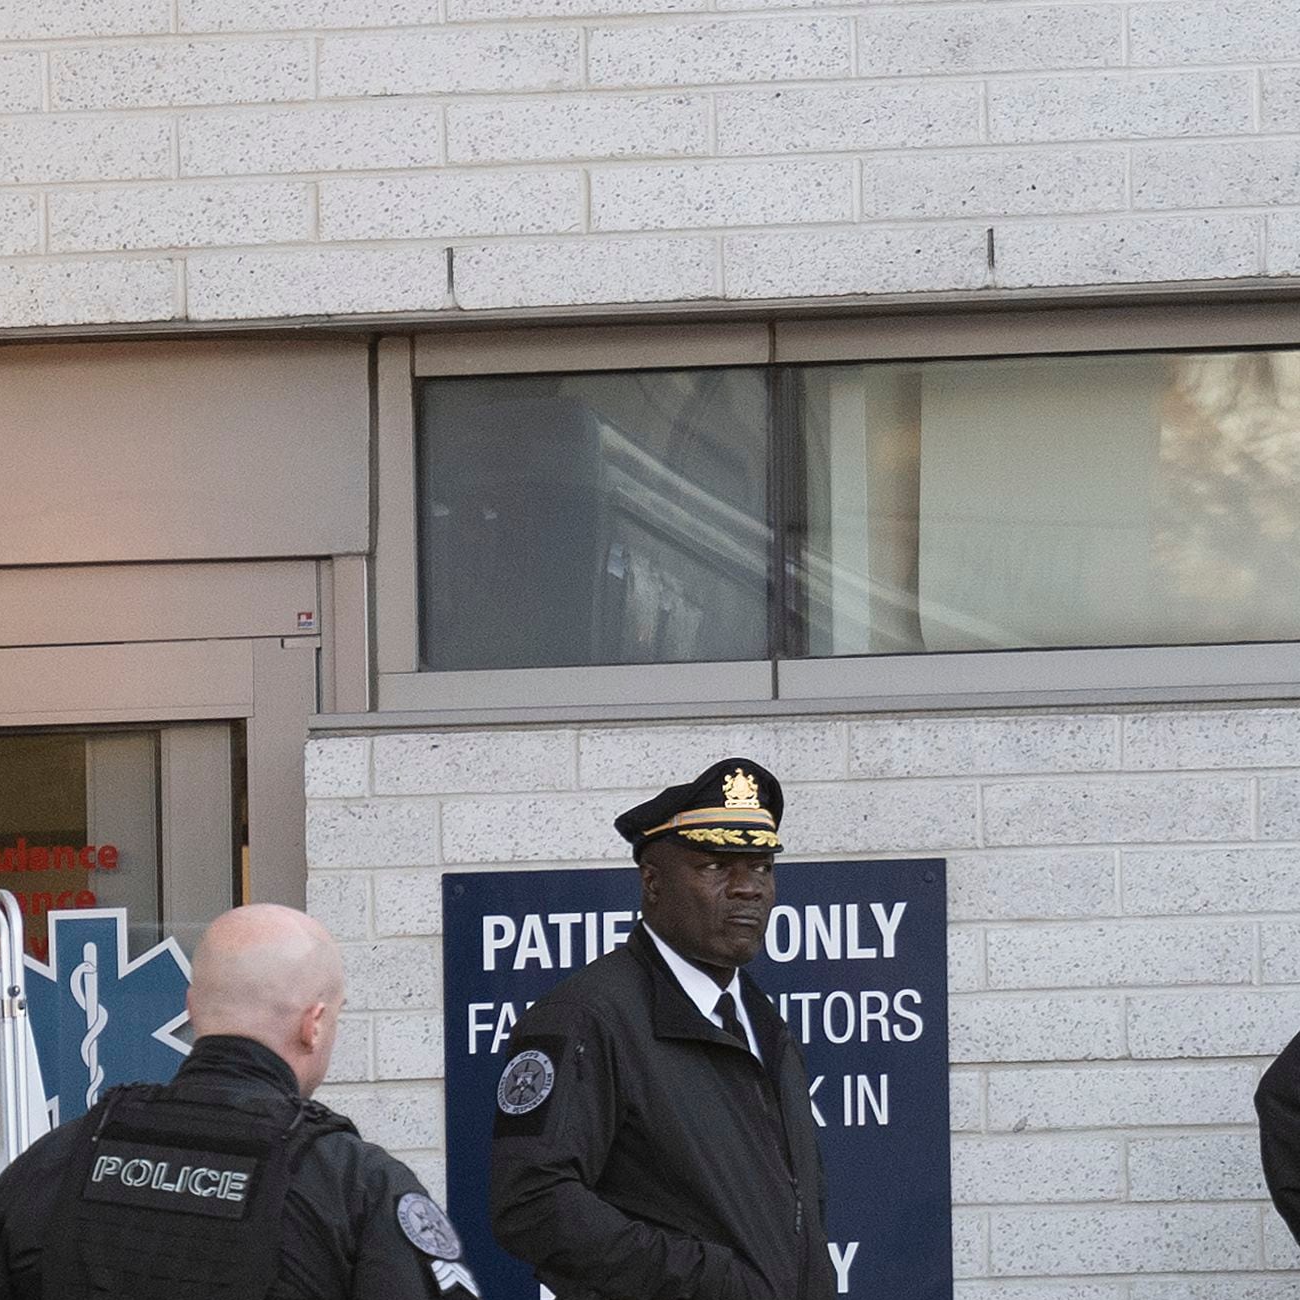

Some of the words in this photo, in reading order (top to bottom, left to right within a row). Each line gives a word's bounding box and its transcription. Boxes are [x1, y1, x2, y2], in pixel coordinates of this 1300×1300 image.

[482, 911, 643, 971] PATIE
[765, 902, 908, 963] ONLY
[767, 989, 924, 1044] ITORS
[843, 1074, 889, 1127] IN
[92, 1155, 249, 1202] POLICE
